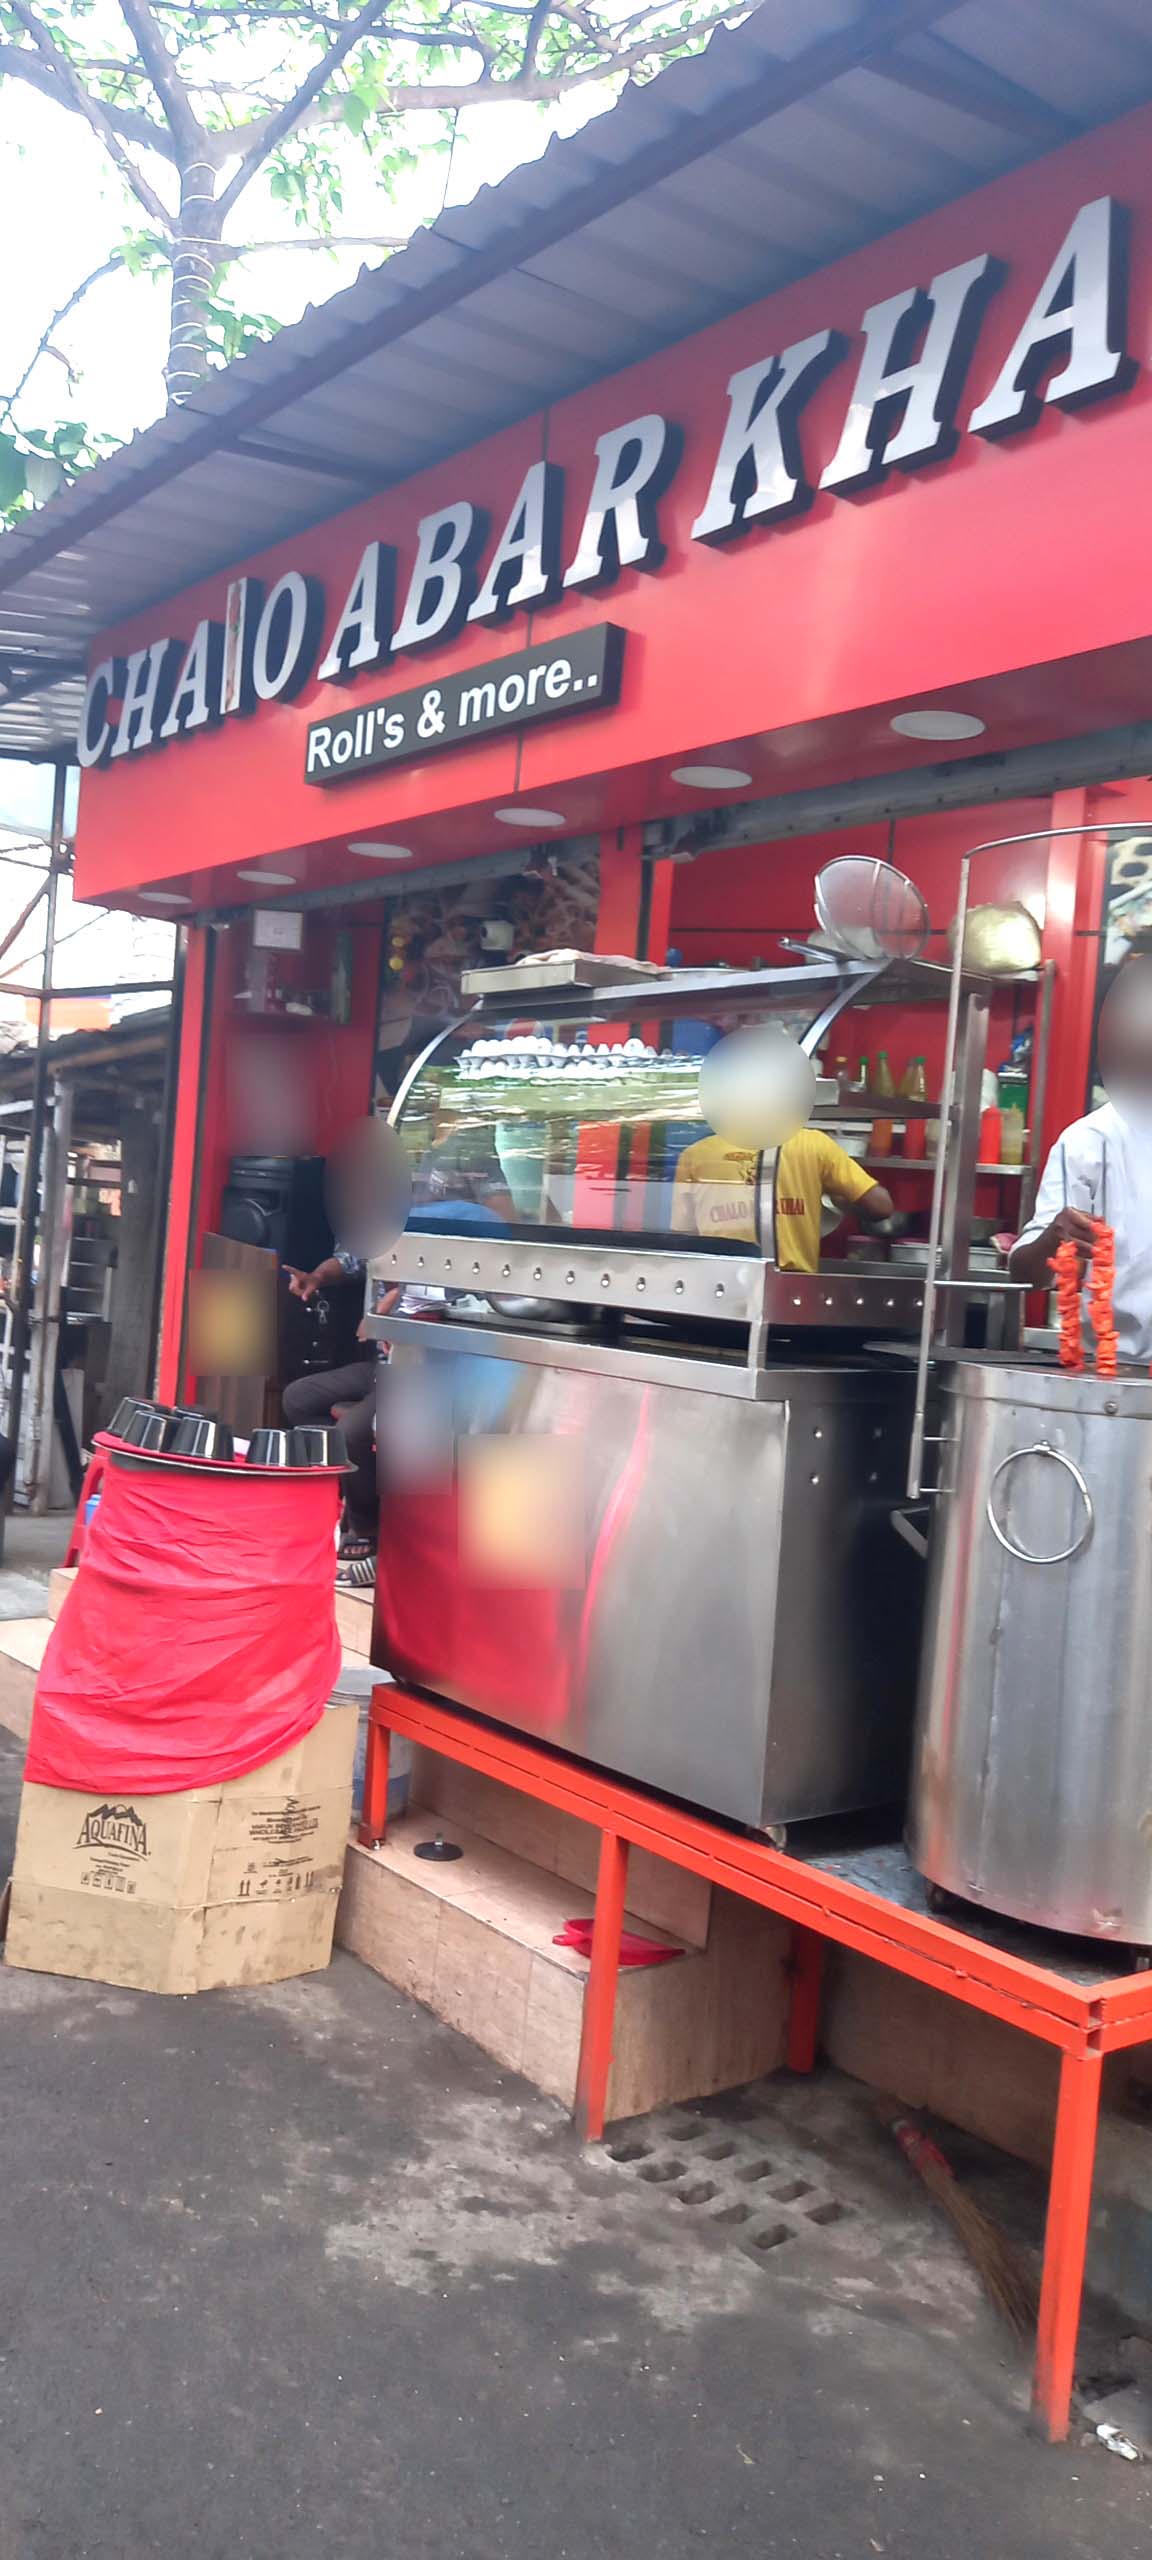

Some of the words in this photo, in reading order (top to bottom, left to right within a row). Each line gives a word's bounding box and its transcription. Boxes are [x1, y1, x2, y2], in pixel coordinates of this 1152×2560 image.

[317, 413, 667, 680] ABAR
[691, 195, 1122, 540] KHA
[307, 707, 405, 772] Roll's
[417, 690, 446, 738] &
[458, 658, 598, 726] more..
[76, 1812, 148, 1856] AQUAFINA
